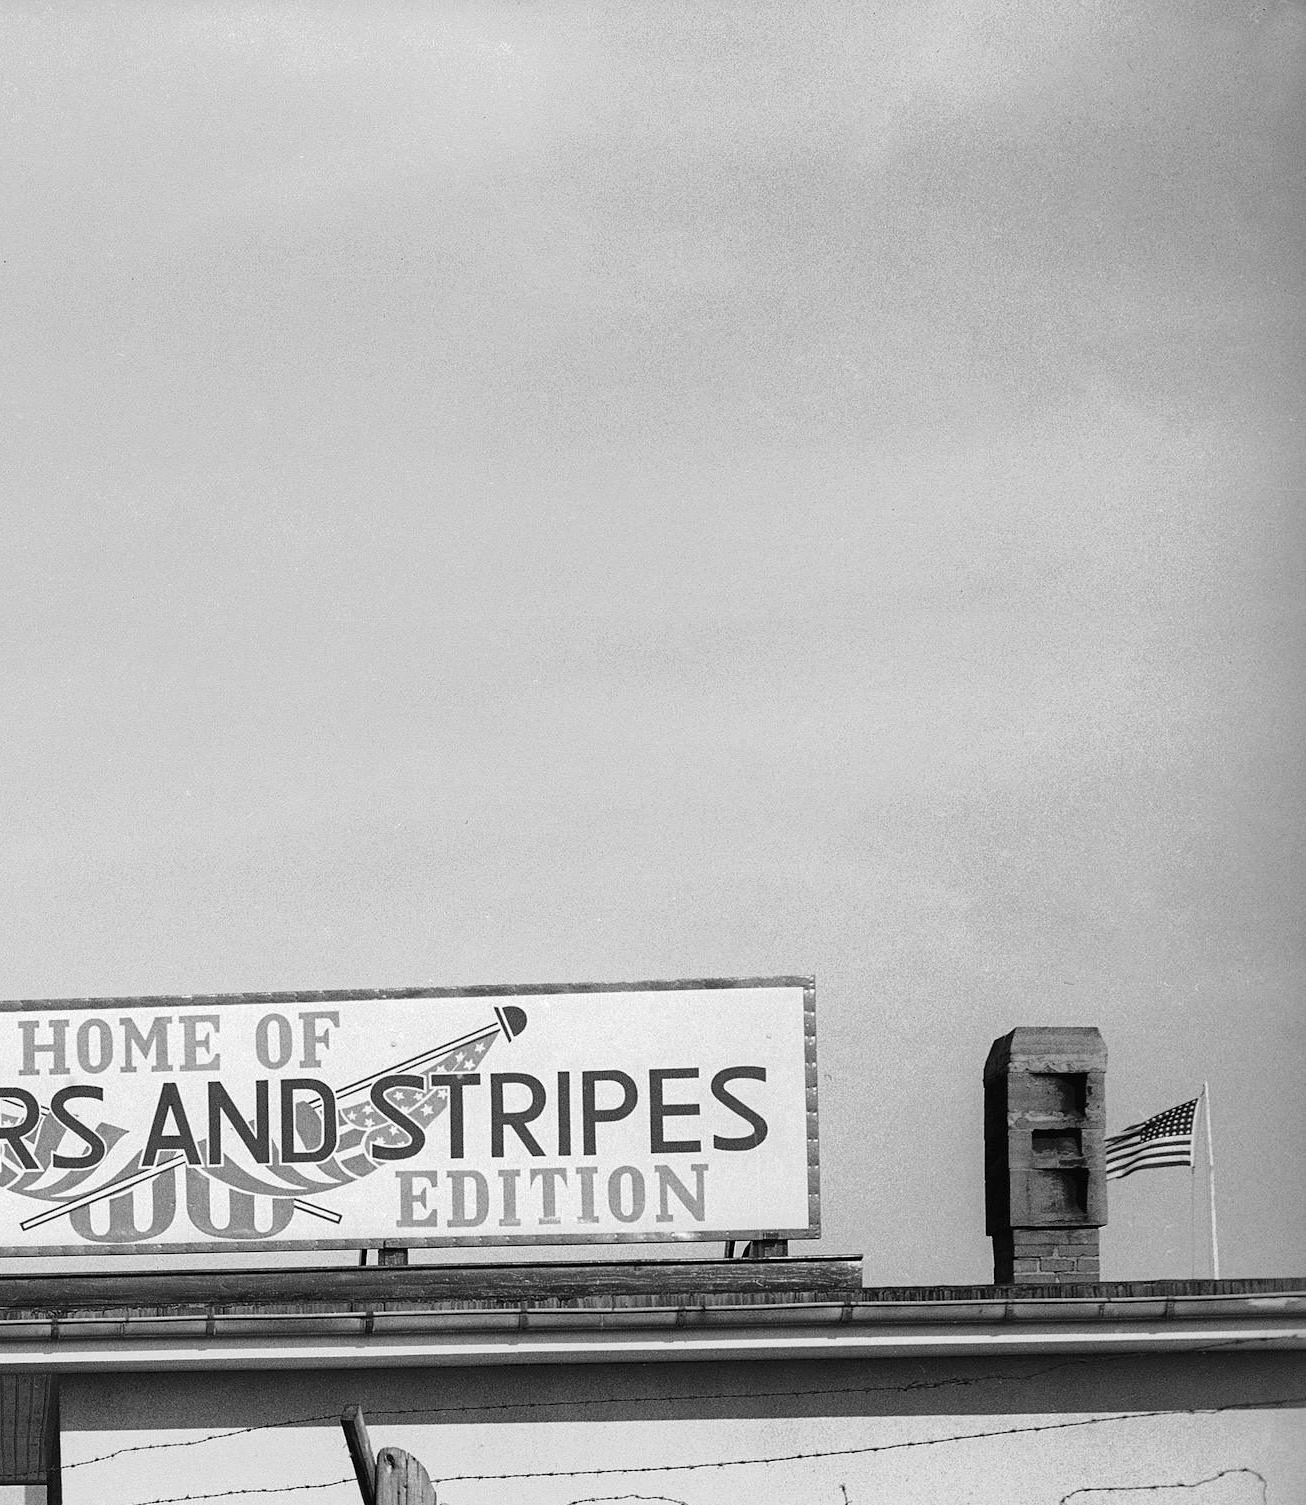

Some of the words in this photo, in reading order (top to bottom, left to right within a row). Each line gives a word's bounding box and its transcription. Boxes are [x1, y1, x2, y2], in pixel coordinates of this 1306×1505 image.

[18, 1013, 221, 1076] HOME
[255, 1010, 340, 1070] OF
[140, 1076, 337, 1169] AND
[370, 1065, 769, 1162] STRIPES
[395, 1163, 710, 1229] EDITION
